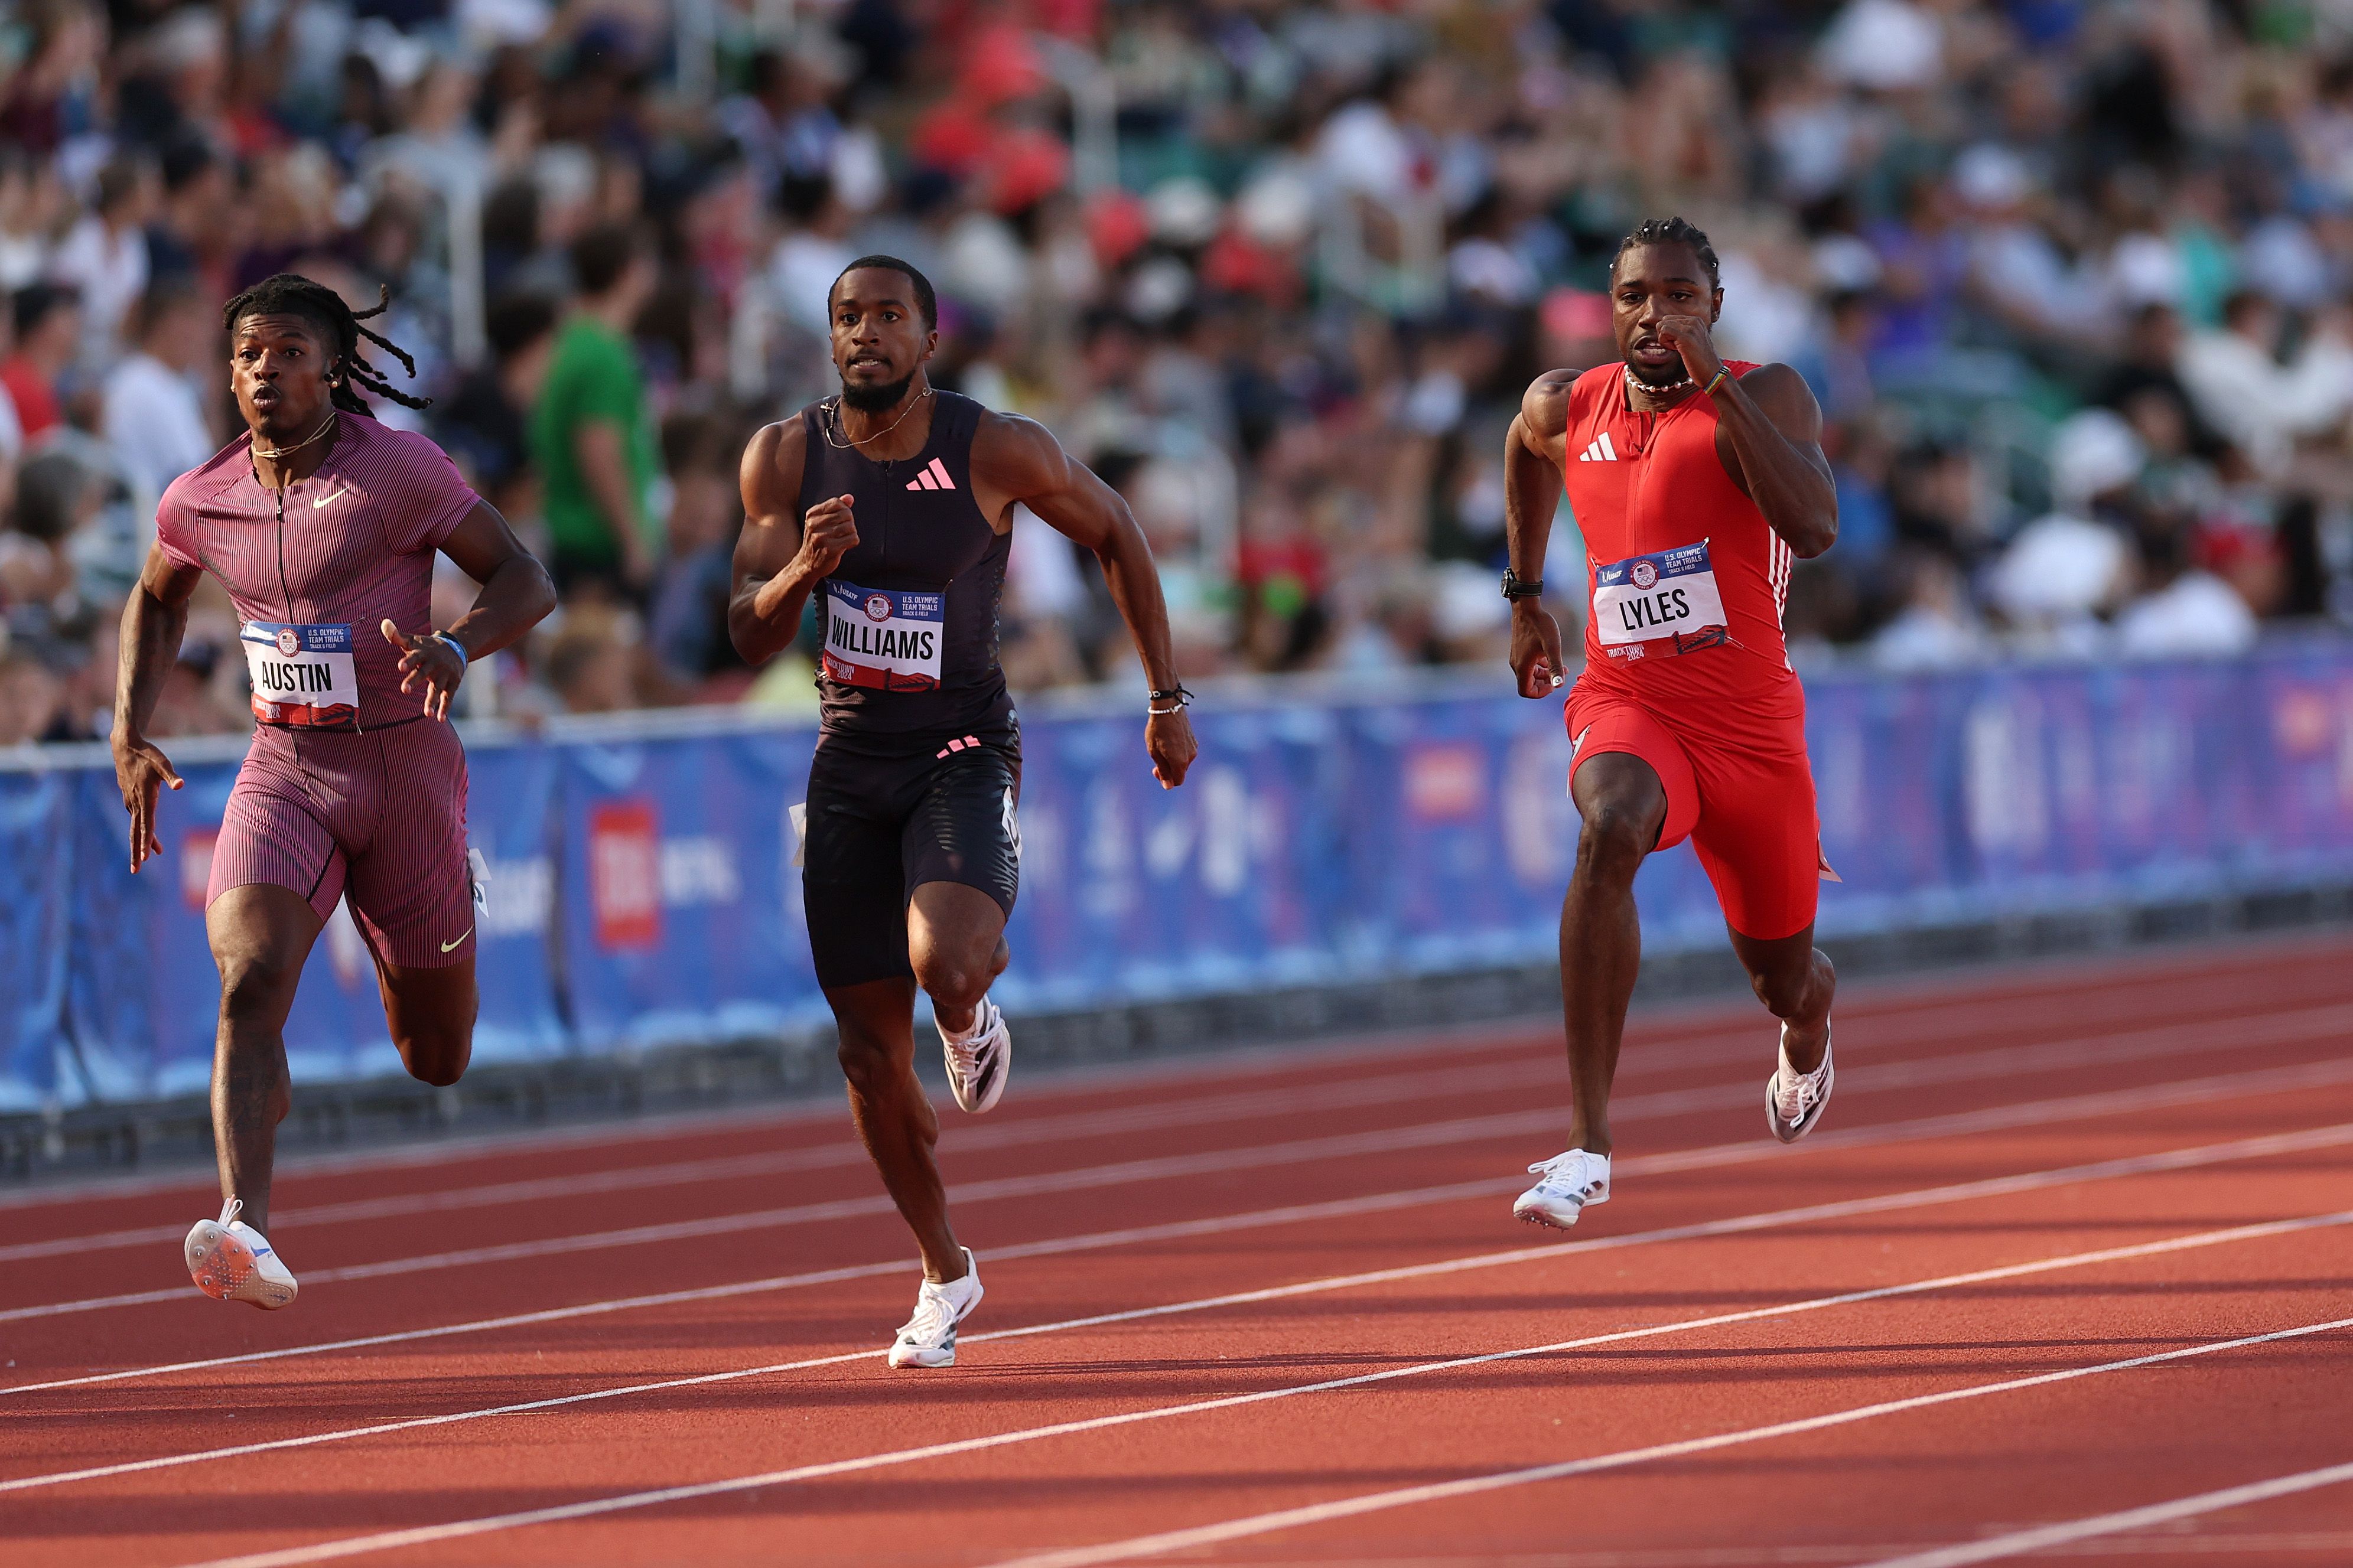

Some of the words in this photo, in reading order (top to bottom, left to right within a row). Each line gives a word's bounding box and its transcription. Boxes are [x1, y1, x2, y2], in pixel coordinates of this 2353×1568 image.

[1677, 547, 1701, 559] OLYMPIC
[1666, 560, 1681, 569] TEAM
[1682, 555, 1703, 565] TRIALS
[842, 588, 858, 601] USATF
[1619, 588, 1690, 631] LYLES
[832, 615, 934, 660] WILLIAMS
[1628, 650, 1645, 661] 2024
[826, 656, 855, 673] TRACKTOWN
[262, 661, 333, 692] AUSTIN
[837, 670, 852, 680] 2024
[266, 710, 281, 719] 2024
